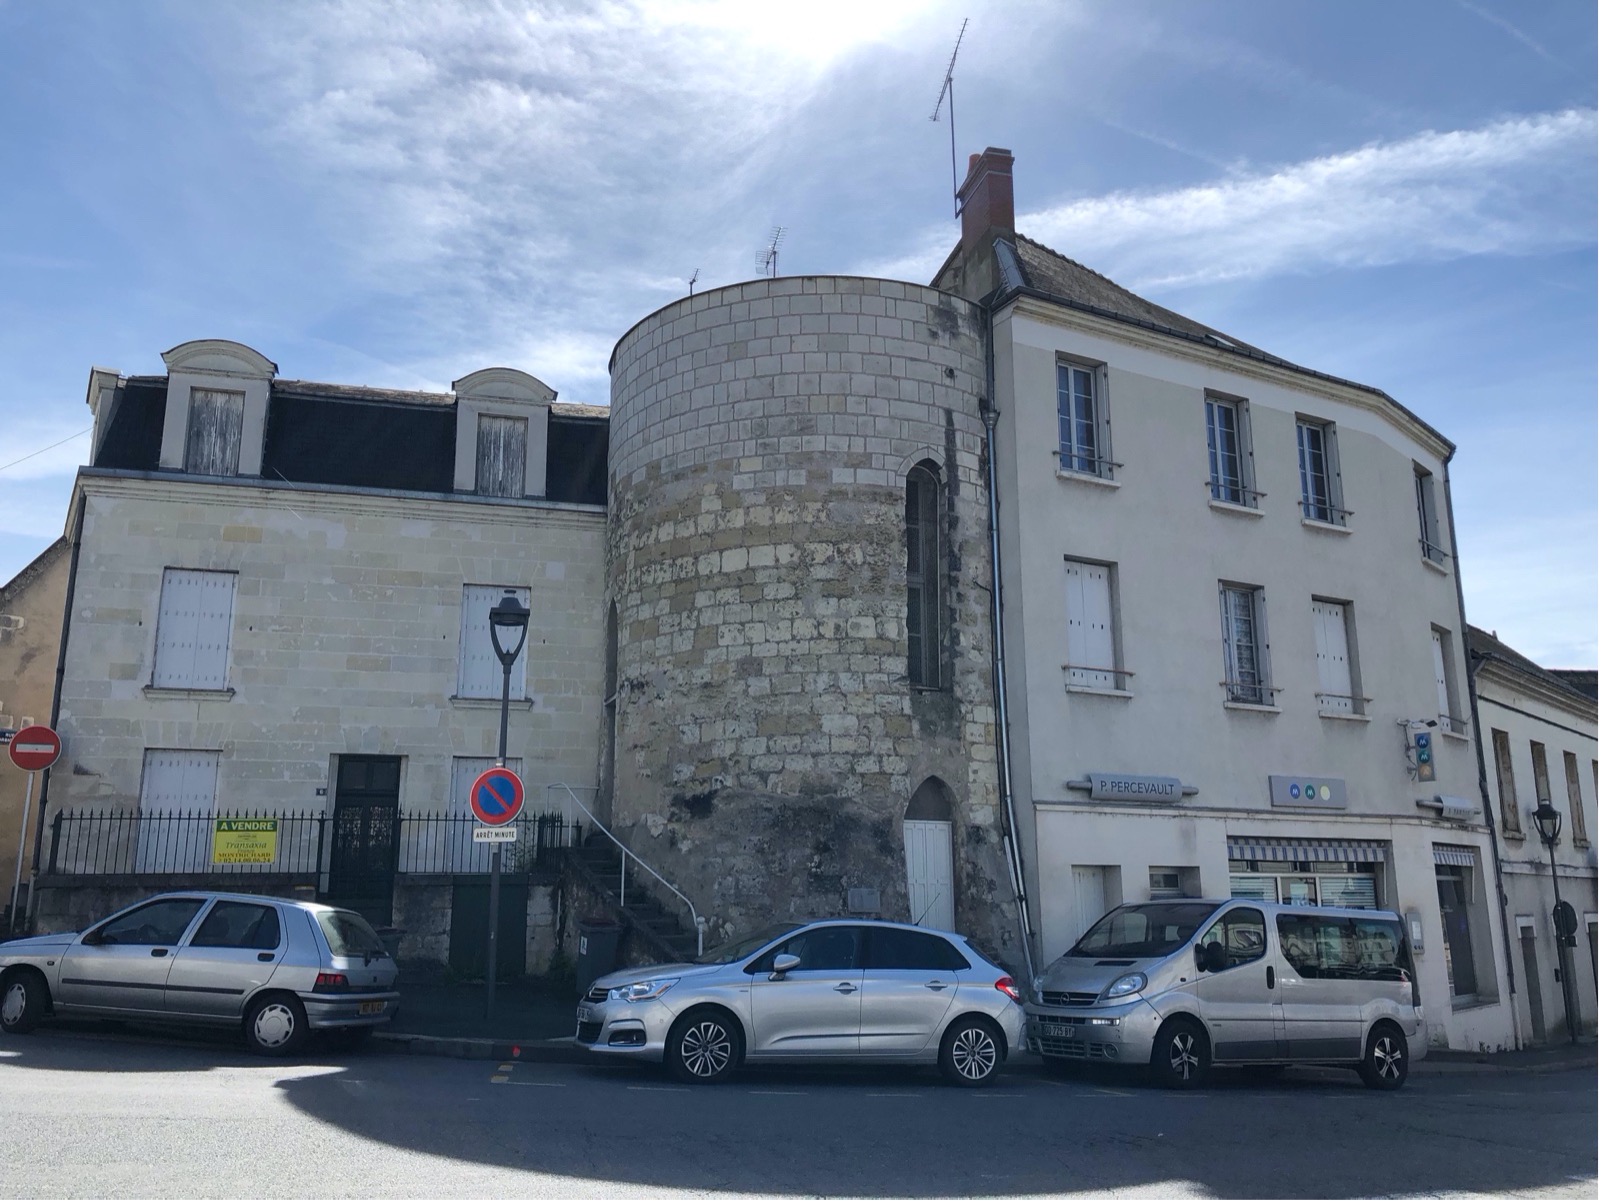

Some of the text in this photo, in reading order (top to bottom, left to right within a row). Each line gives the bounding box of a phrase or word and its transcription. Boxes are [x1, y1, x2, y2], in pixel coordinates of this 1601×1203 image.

[1100, 780, 1174, 795] P. PERCEVAULT
[220, 822, 274, 830] A VENDRE
